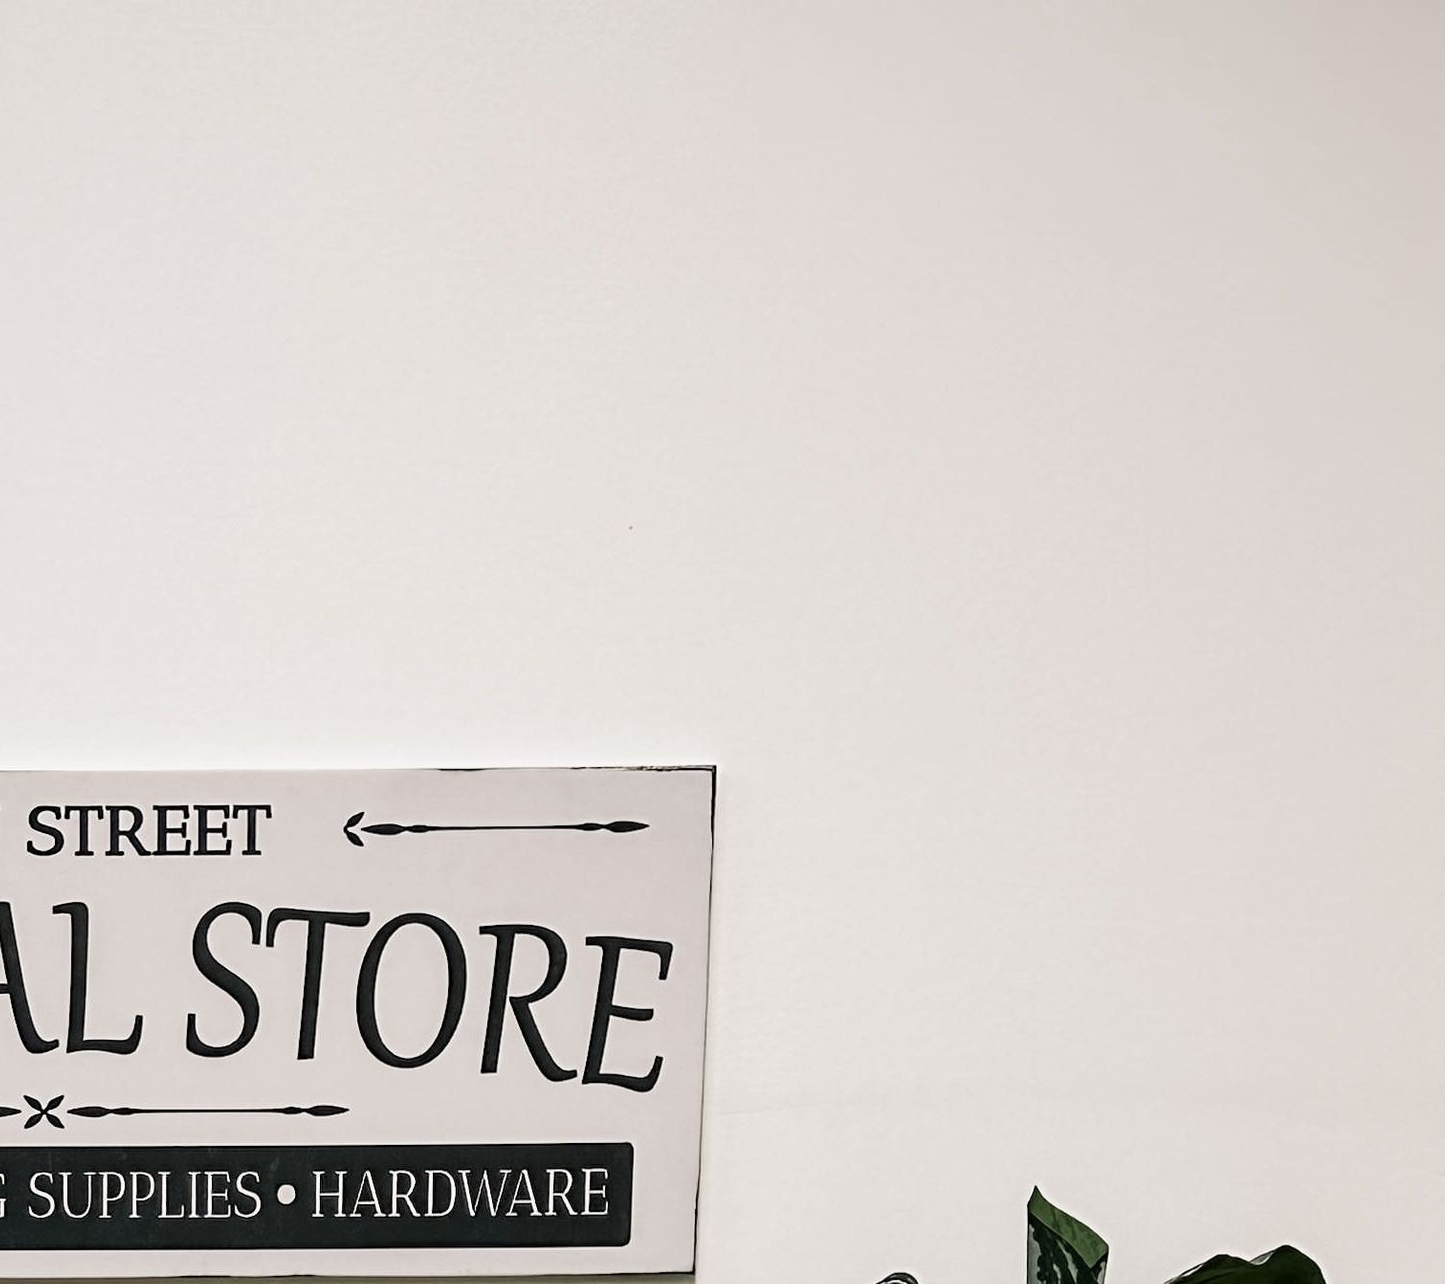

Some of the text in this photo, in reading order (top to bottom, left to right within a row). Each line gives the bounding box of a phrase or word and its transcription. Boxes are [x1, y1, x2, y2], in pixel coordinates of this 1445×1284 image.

[27, 804, 273, 857] STREET
[186, 901, 674, 1093] STORE
[28, 1171, 262, 1219] SUPPLIES
[312, 1168, 609, 1218] HARDWARE
